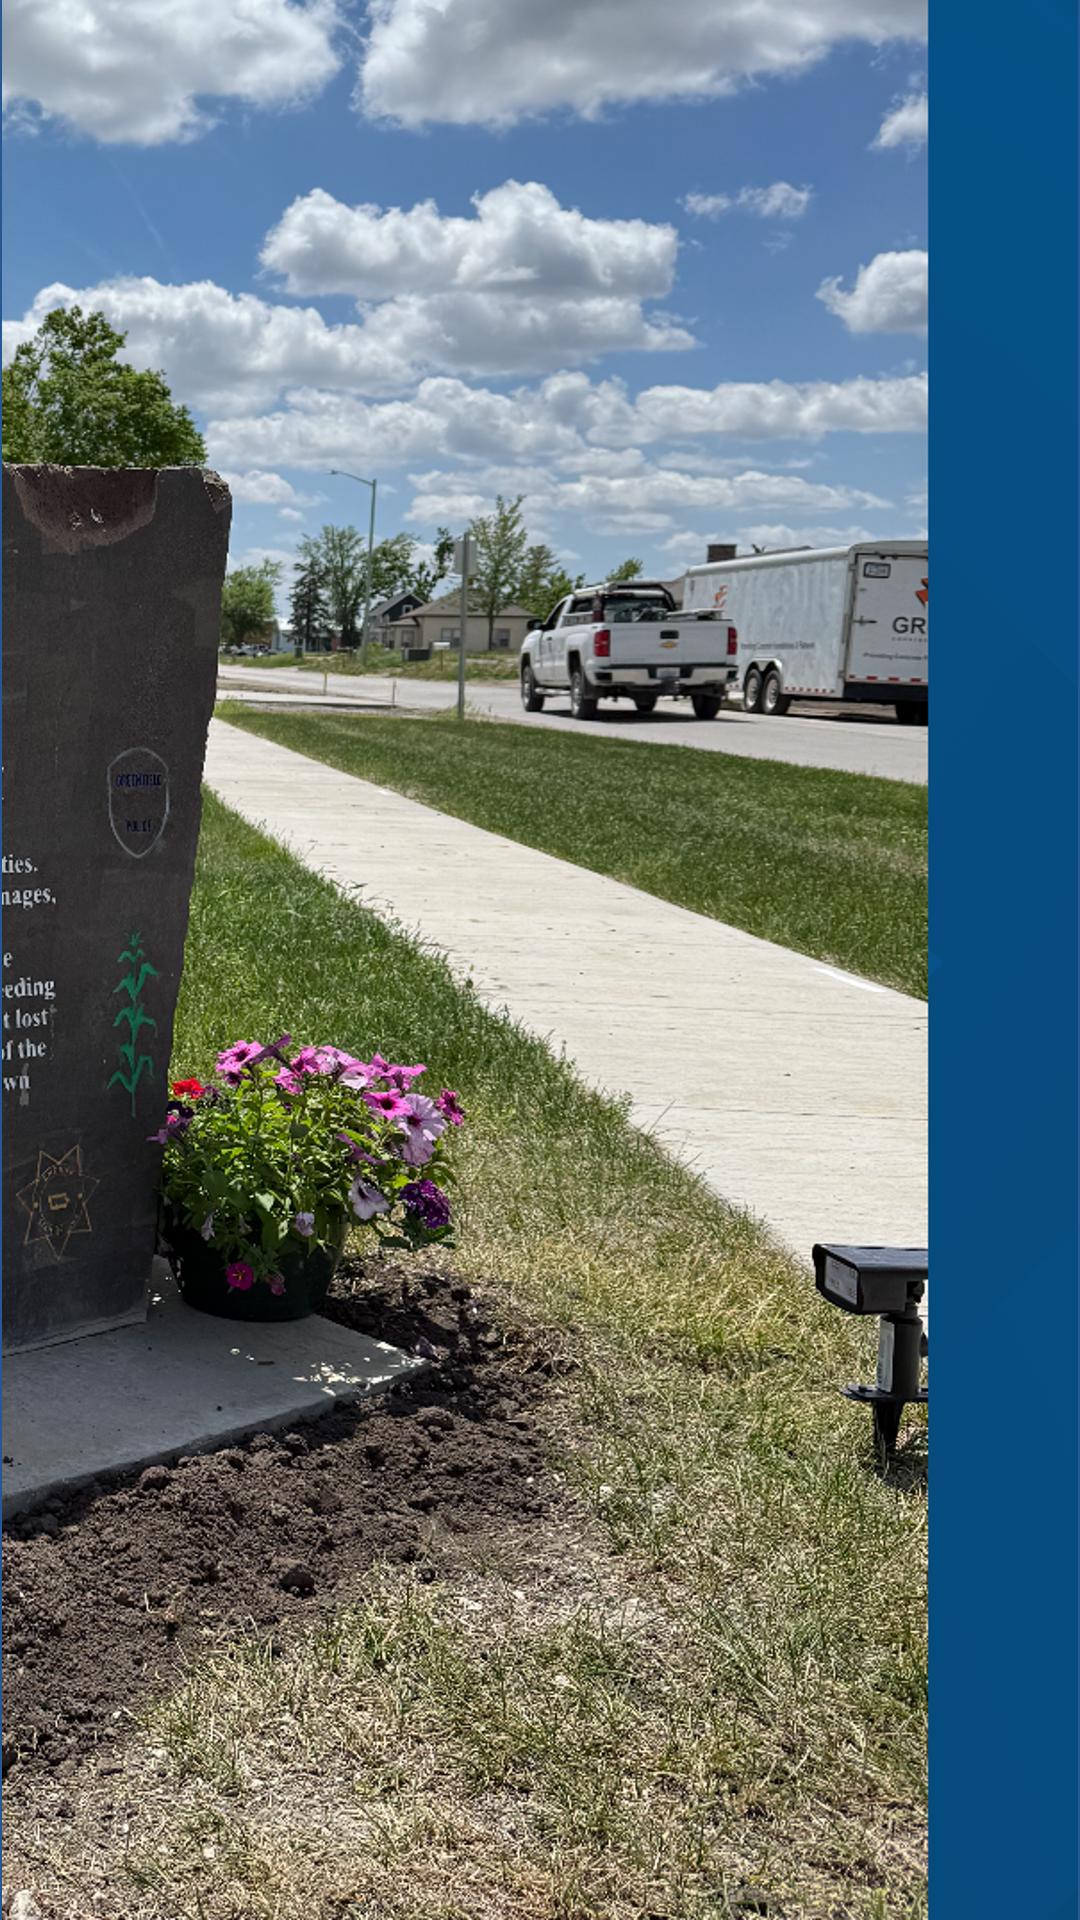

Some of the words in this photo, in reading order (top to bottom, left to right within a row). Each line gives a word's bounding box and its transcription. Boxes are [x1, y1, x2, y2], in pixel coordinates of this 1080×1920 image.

[2, 976, 56, 1000] eding
[15, 1008, 48, 1029] lost
[17, 1038, 47, 1059] the
